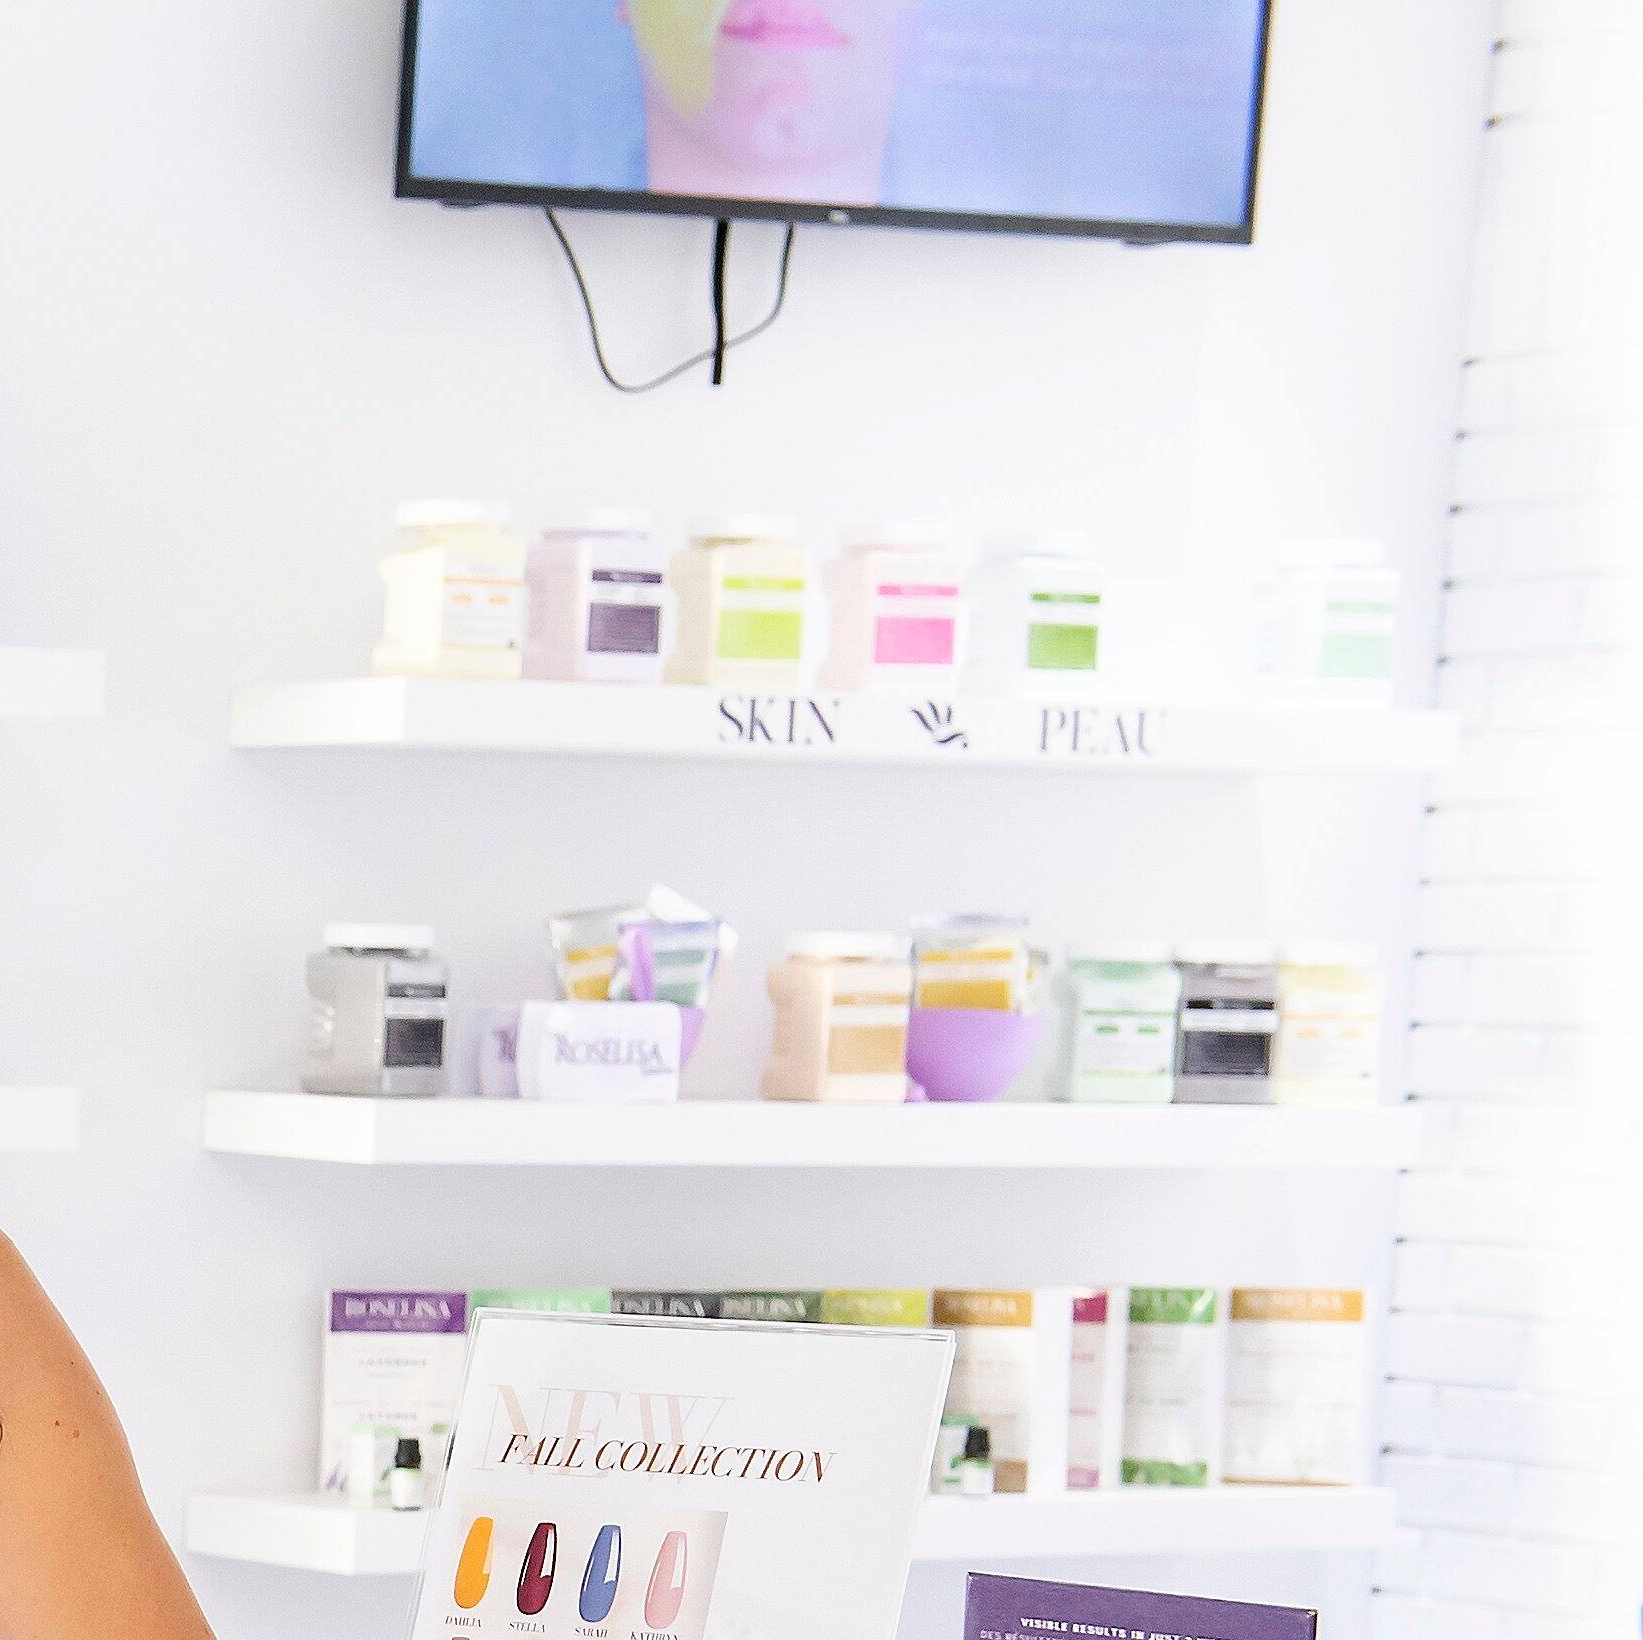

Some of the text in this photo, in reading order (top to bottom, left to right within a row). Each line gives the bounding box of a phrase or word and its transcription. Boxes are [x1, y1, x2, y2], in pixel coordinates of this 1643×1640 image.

[717, 695, 1169, 756] SKIN PEAU
[472, 1384, 735, 1483] NEW
[497, 1434, 837, 1483] FALL COLLECTION
[444, 1615, 482, 1628] DAHLIA
[508, 1621, 546, 1633] STELLA
[574, 1627, 609, 1638] SARAH
[1019, 1617, 1068, 1632] VISIBLE
[1072, 1623, 1127, 1639] RESULTS
[1130, 1629, 1145, 1640] IN
